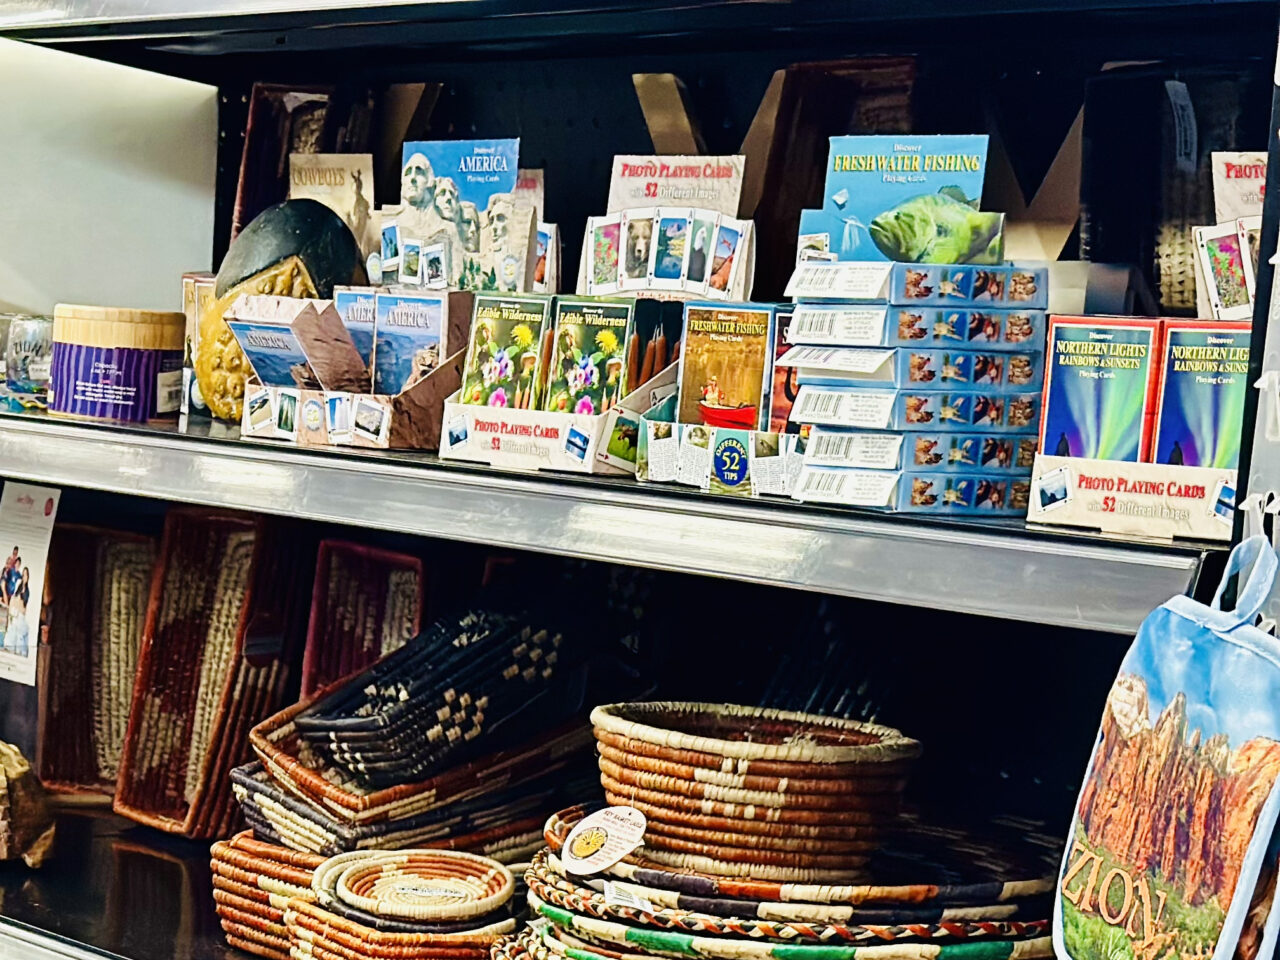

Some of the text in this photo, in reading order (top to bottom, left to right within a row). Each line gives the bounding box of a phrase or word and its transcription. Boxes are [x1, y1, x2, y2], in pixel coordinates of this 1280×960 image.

[458, 155, 510, 173] AMERICA
[621, 163, 734, 179] PHOTO PLAYING CARDS
[833, 155, 981, 173] FRESHWATER FISHING
[881, 174, 907, 185] Playing
[644, 182, 658, 198] 52
[659, 186, 695, 201] Different
[386, 307, 433, 329] AMERICA
[476, 306, 543, 322] Edible Wilderness
[559, 313, 627, 328] Edible Wilderness
[689, 320, 735, 334] FRESHWATER
[735, 321, 766, 336] FISHING
[1055, 340, 1147, 358] NORTHERN LIGHTS
[1171, 344, 1228, 361] NORTHERN
[1058, 355, 1101, 368] RAINBOWS
[1105, 357, 1141, 370] SUNSETS
[1173, 360, 1219, 373] RAINBOWS
[474, 418, 560, 440] PHOTO PLAYING CARDS
[715, 438, 748, 460] DIFFERENT
[721, 451, 741, 471] 52
[723, 471, 738, 481] TIPS
[1077, 473, 1207, 500] PHOTO PLAYING CARDS
[1102, 496, 1117, 513] 52
[1118, 503, 1156, 518] Different
[1160, 505, 1191, 521] Images
[1061, 841, 1167, 948] ZION
